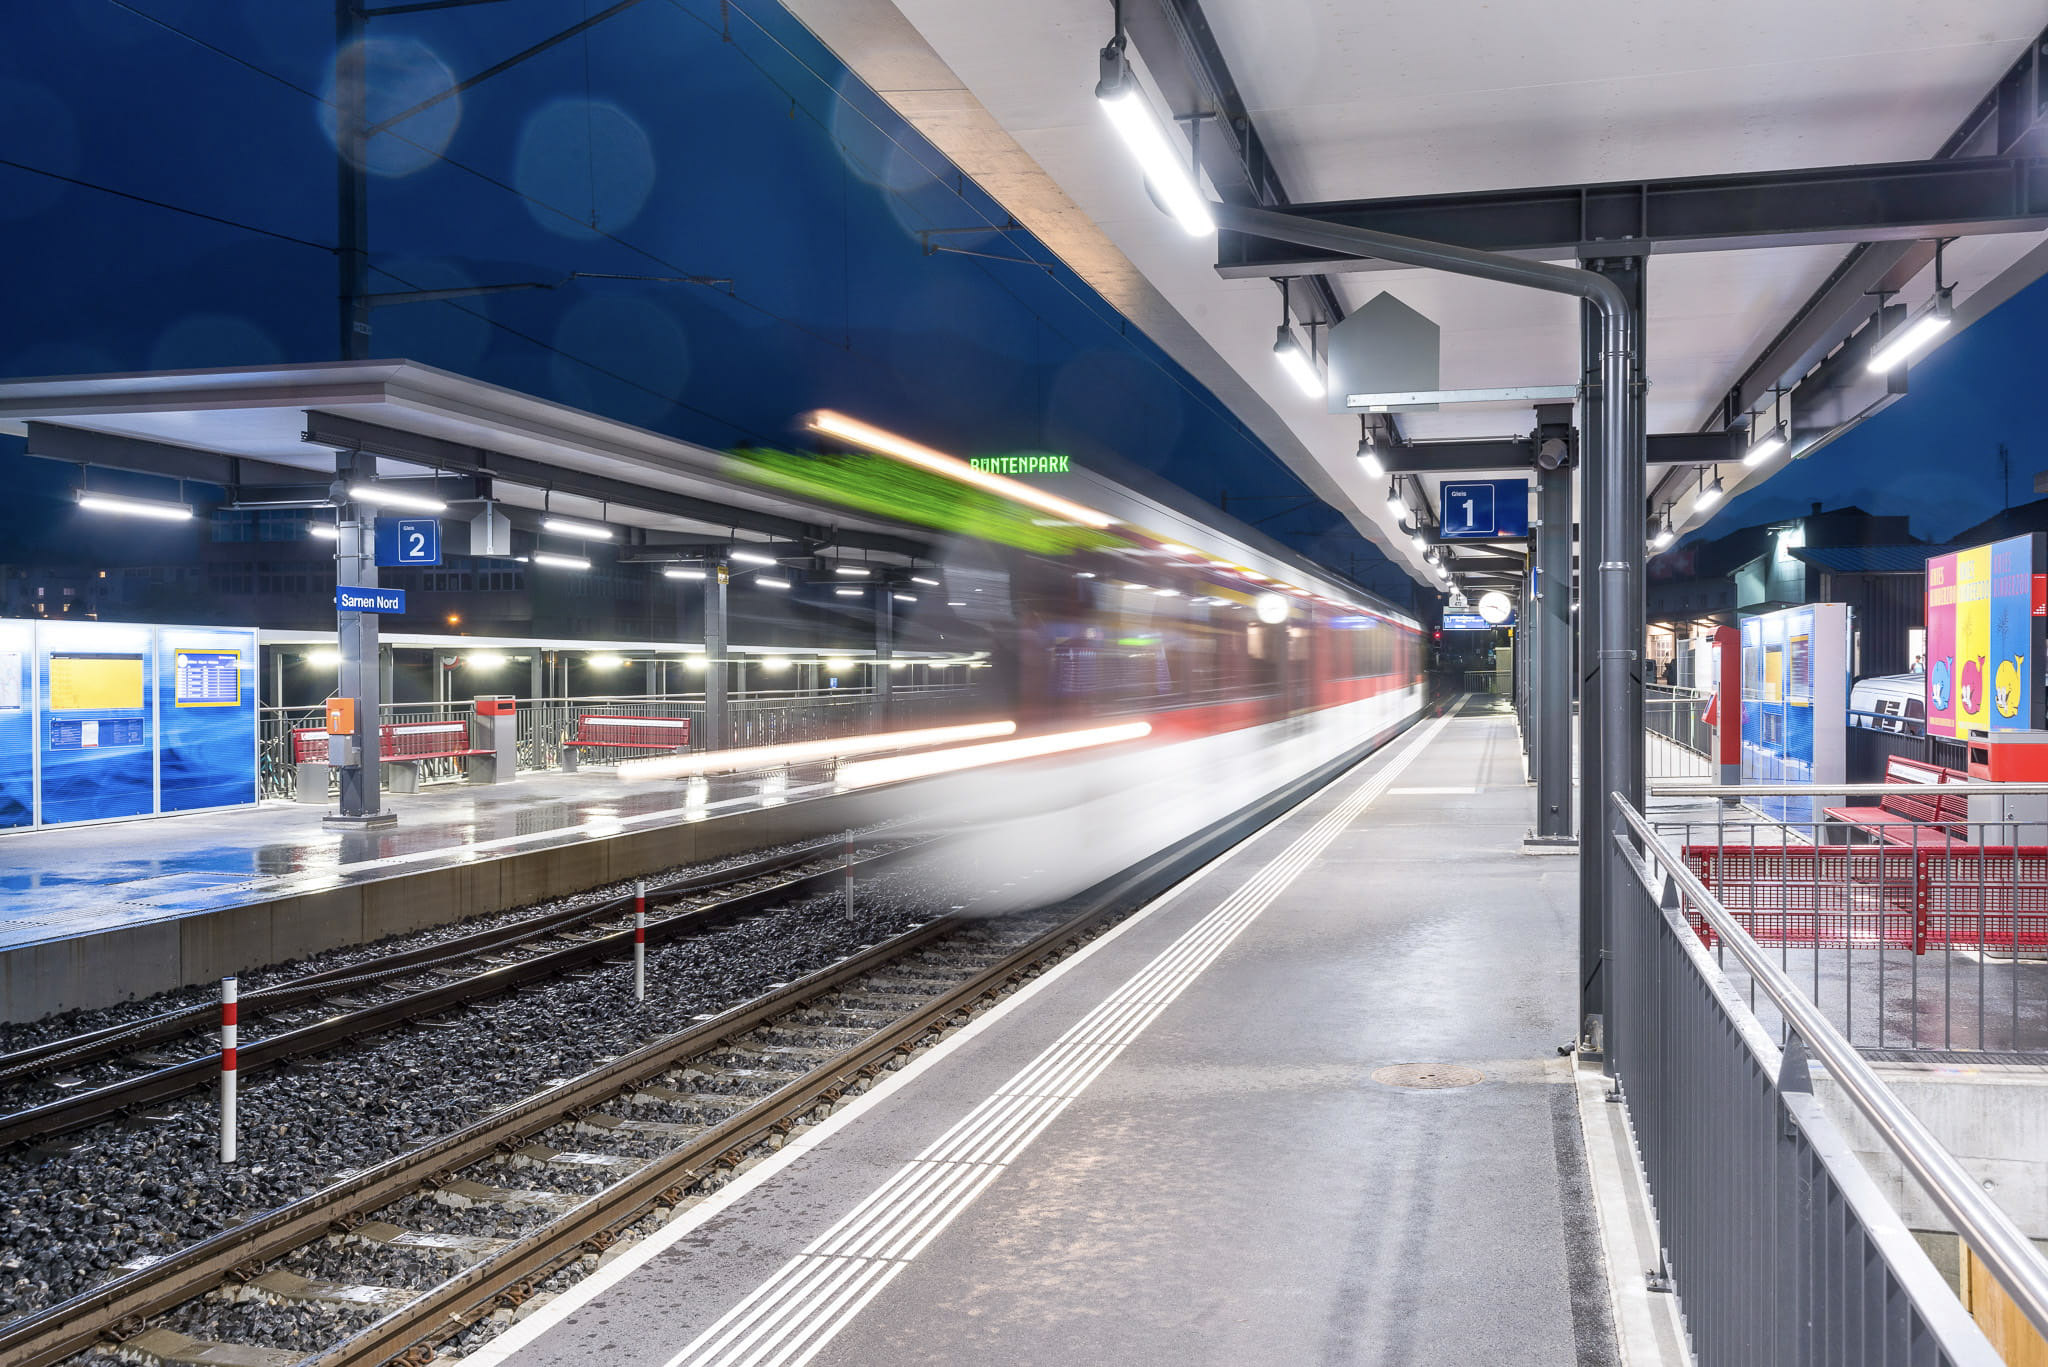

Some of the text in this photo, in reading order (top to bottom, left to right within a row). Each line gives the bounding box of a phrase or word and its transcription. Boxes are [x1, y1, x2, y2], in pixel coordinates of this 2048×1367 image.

[1462, 499, 1473, 527] 1
[409, 533, 425, 557] 2
[341, 593, 399, 609] Sarnen Nord
